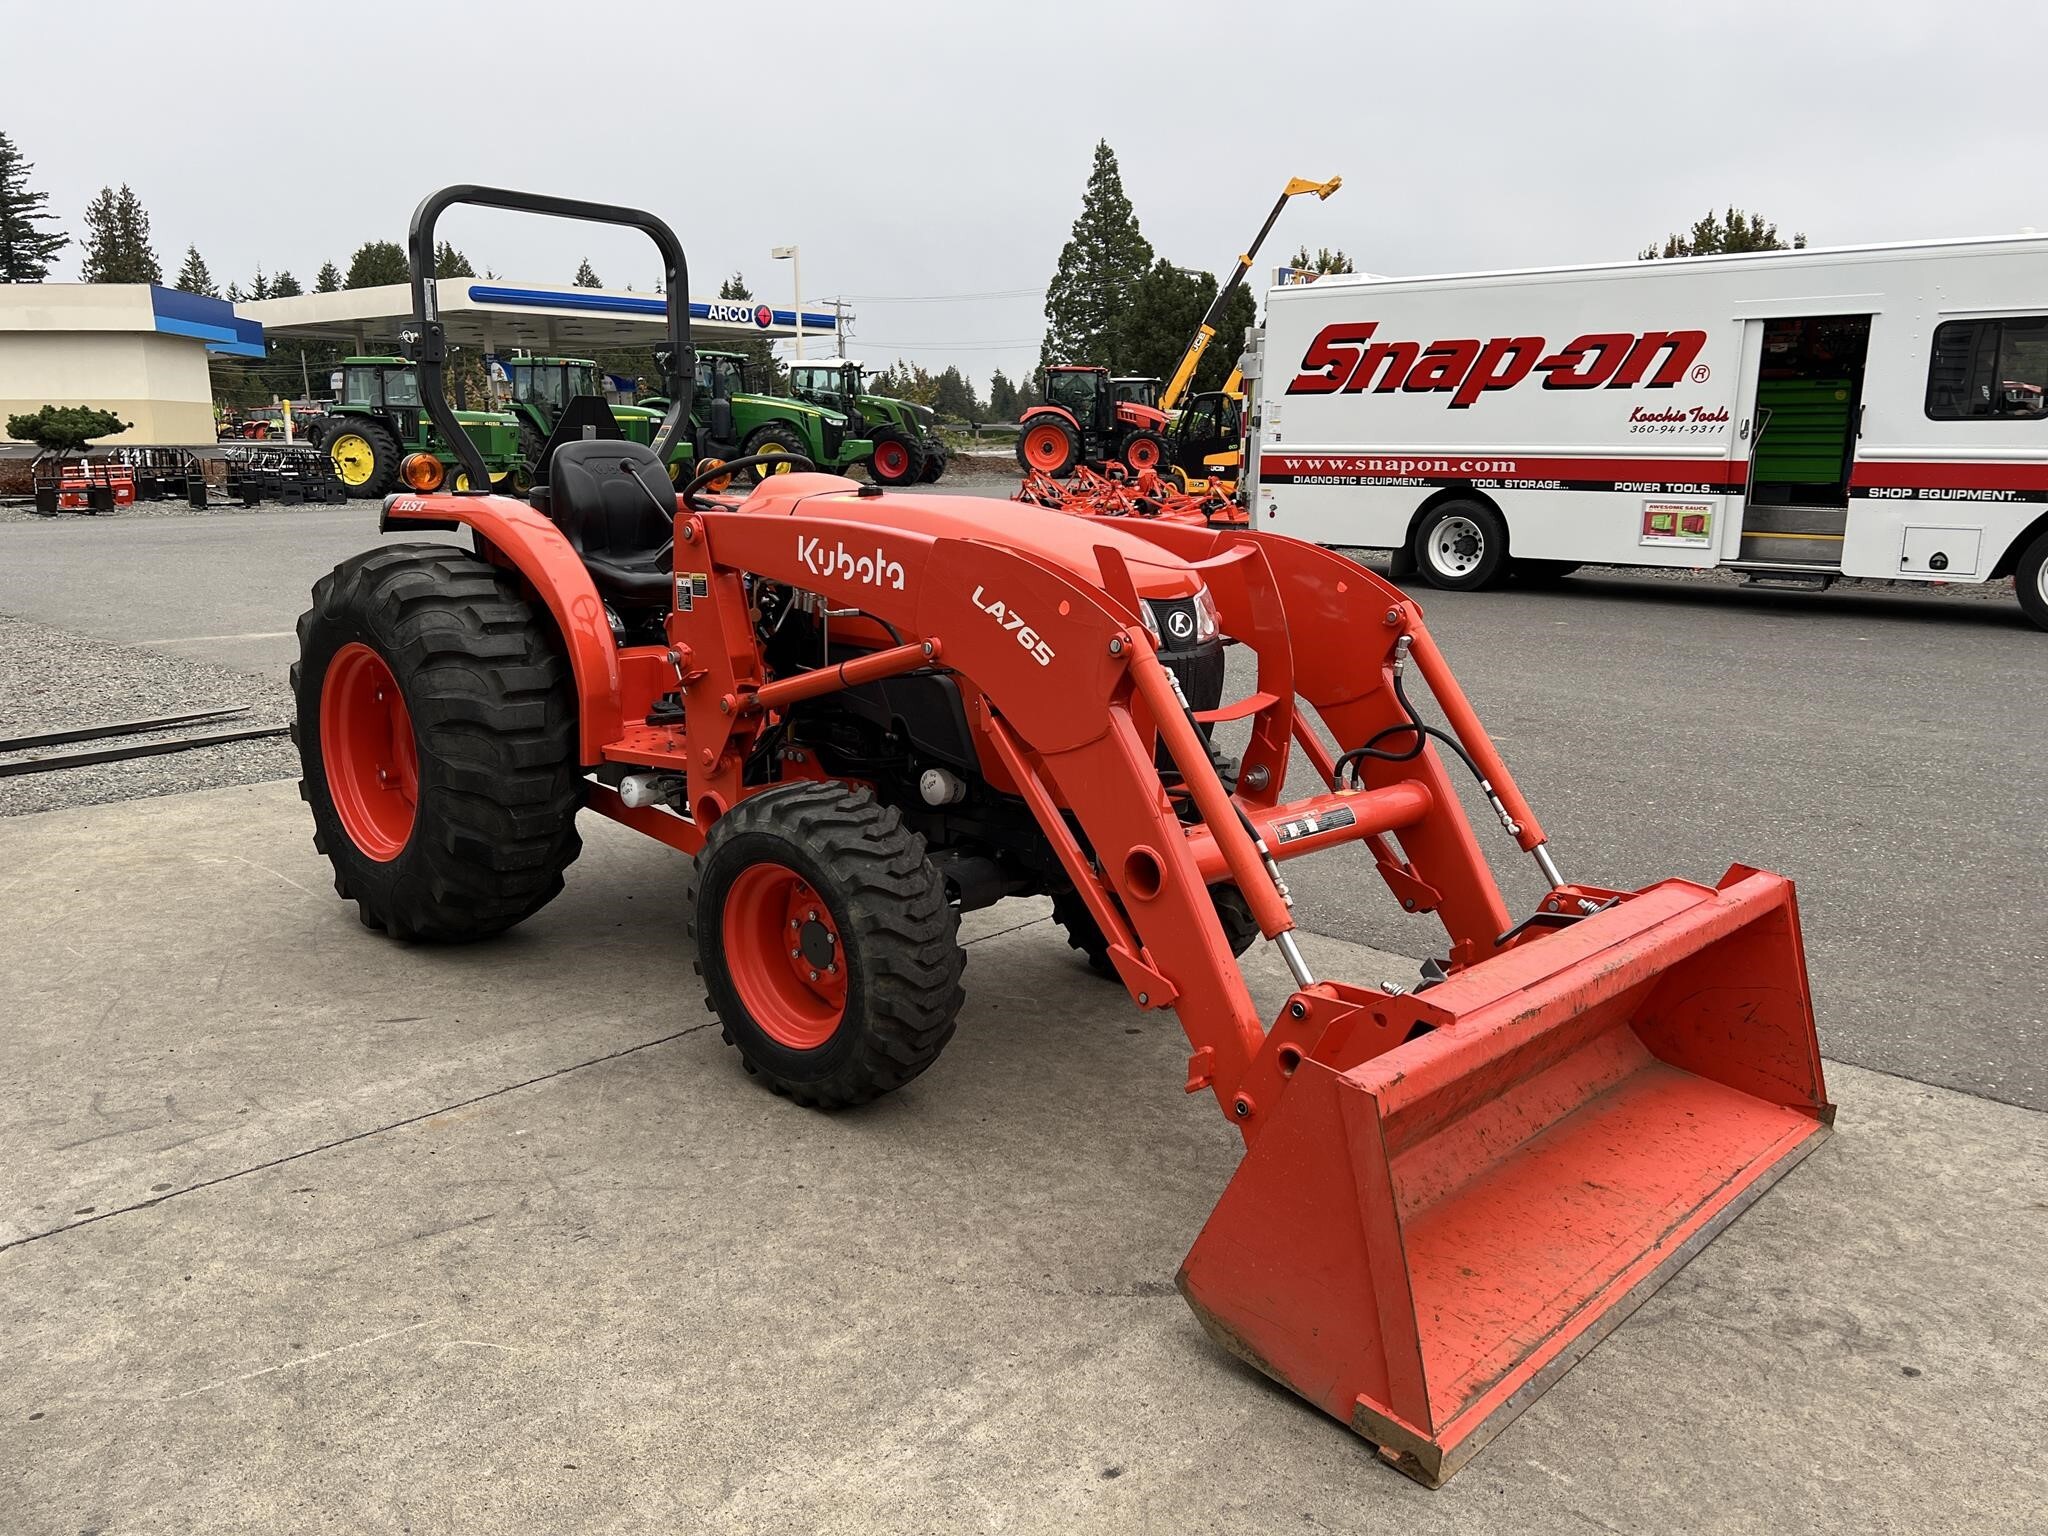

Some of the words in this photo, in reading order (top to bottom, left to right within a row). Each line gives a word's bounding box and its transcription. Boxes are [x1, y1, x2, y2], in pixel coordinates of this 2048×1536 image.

[707, 304, 749, 322] ARCO
[1629, 406, 1686, 422] Koochie
[1689, 405, 1729, 422] Tools
[1630, 424, 1724, 434] 360-941-9311
[1283, 459, 1516, 475] www.snapon.com
[1293, 475, 1357, 485] DIAGNOSTIC
[1471, 478, 1500, 488] TOOL
[1614, 482, 1660, 492] POWER
[1868, 487, 1912, 498] SHOP
[398, 500, 428, 511] HST
[797, 535, 905, 591] Kubota
[971, 585, 1056, 666] LA765
